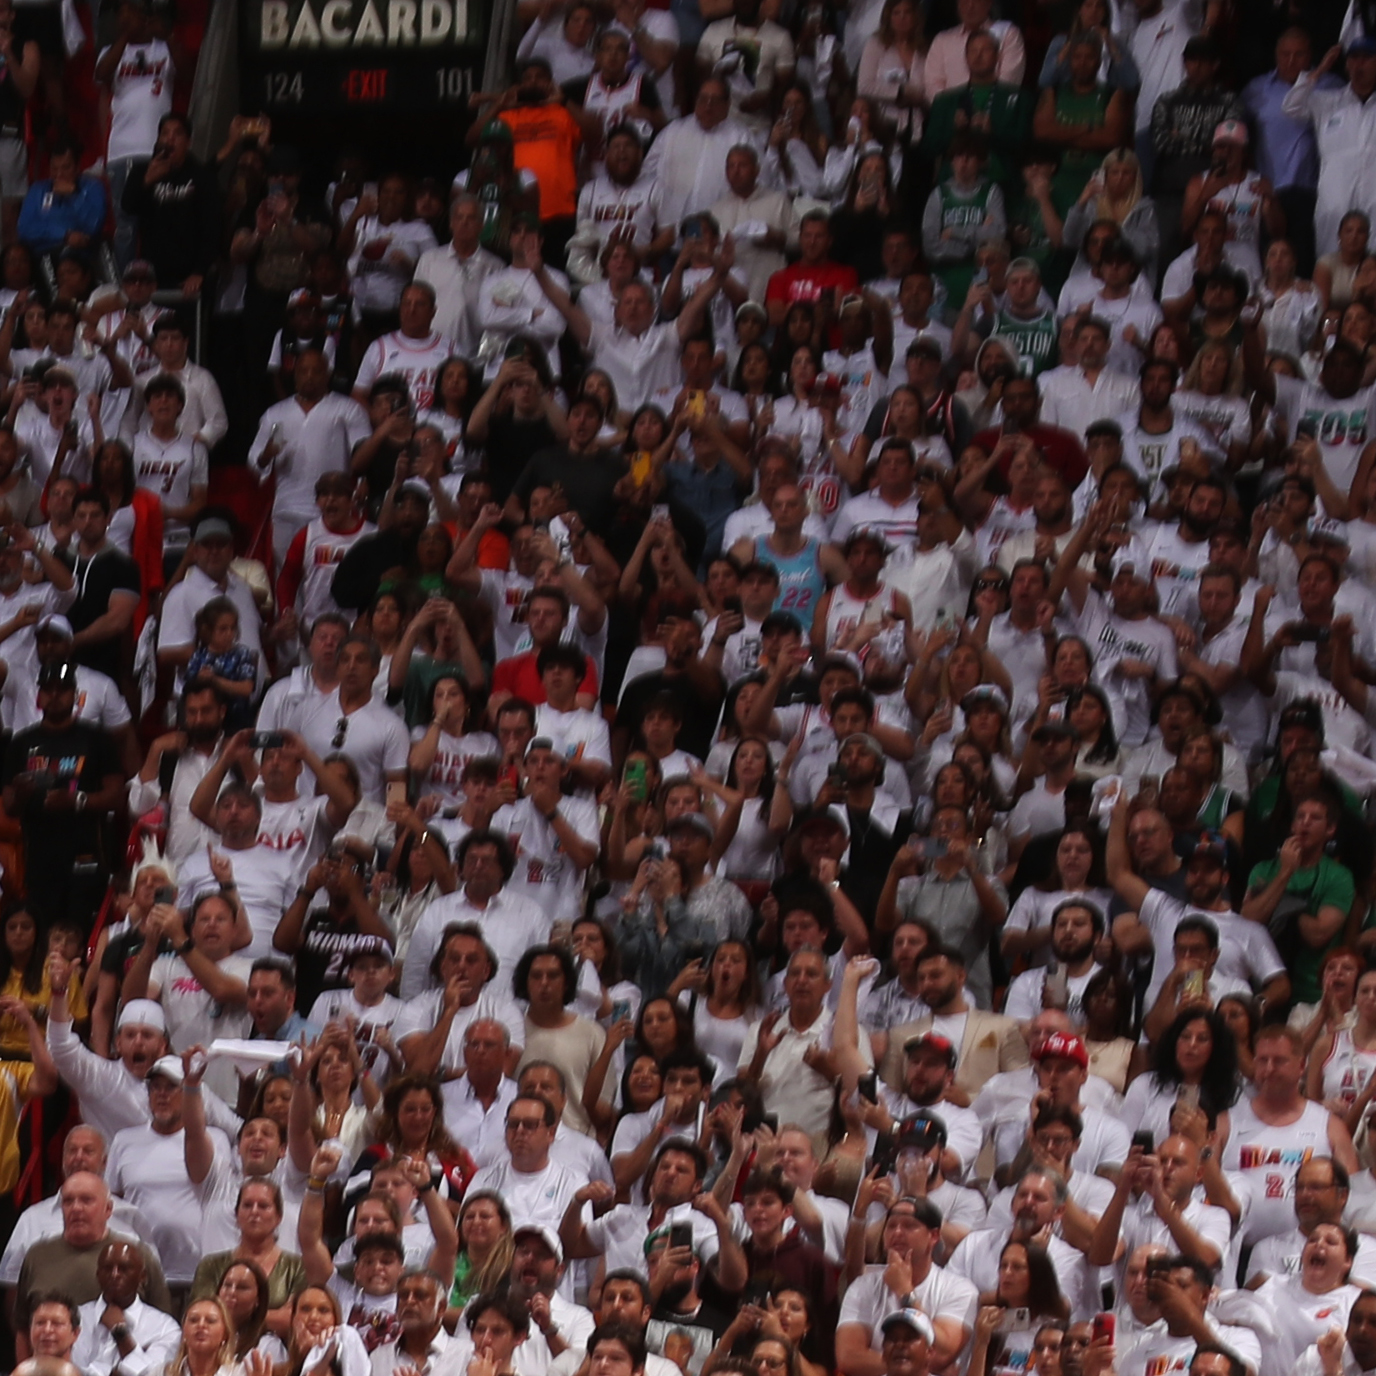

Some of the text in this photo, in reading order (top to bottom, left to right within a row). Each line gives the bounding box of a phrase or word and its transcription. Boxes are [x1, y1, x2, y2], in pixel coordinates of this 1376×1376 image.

[261, 0, 469, 48] BACARDI
[264, 67, 473, 104] 124 EXIT 101
[780, 586, 813, 608] 22
[257, 830, 307, 851] AIA
